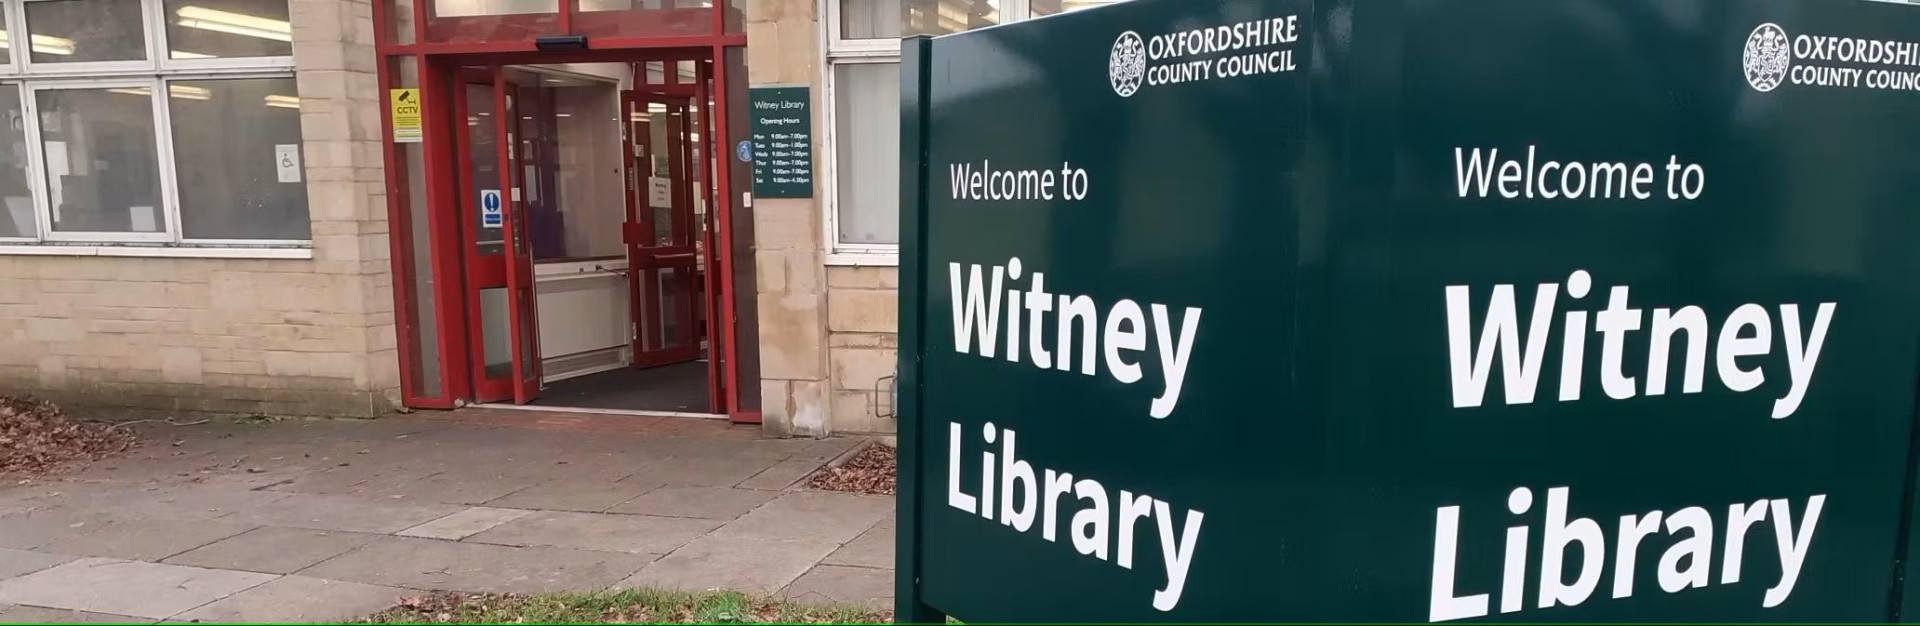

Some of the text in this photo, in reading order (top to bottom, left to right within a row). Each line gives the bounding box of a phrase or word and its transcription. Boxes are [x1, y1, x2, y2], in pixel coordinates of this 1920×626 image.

[1148, 15, 1298, 60] OXFORDSHIRE
[1793, 34, 1920, 66] OXFORDSHI
[1147, 50, 1297, 86] COUNTY COUNCIL
[1791, 65, 1862, 87] COUNTY
[396, 106, 419, 114] CCTV
[754, 100, 805, 110] Witney Library
[760, 117, 782, 125] Opening
[950, 159, 1088, 201] Welcome to
[1456, 145, 1705, 200] Welcome to
[949, 256, 1203, 419] Witney
[1445, 269, 1837, 419] Witney
[948, 421, 1205, 612] Library
[1429, 486, 1827, 623] Library
